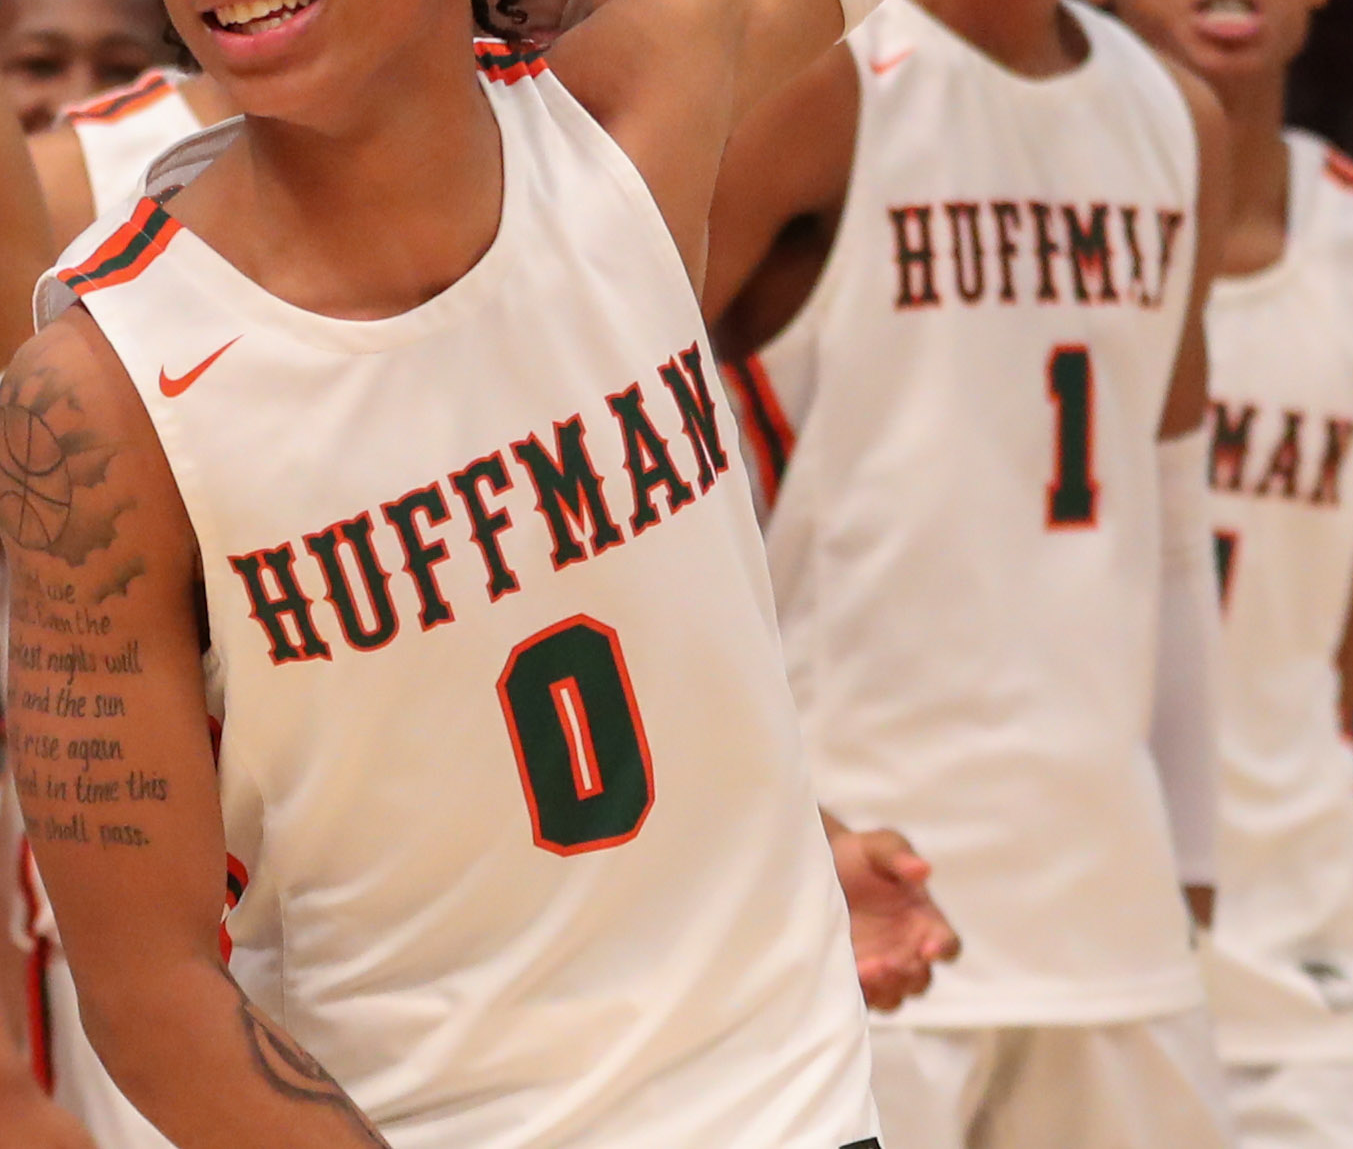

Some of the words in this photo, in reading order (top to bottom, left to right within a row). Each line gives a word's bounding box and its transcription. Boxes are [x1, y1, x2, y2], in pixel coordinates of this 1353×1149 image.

[1044, 343, 1100, 532] 1
[227, 339, 729, 666] HUFFMAN
[104, 639, 144, 675] will
[55, 687, 88, 718] the
[93, 693, 126, 719] sun
[495, 612, 656, 858] 0
[66, 738, 125, 772] again
[47, 774, 67, 800] in
[76, 774, 121, 804] time
[125, 769, 170, 802] this
